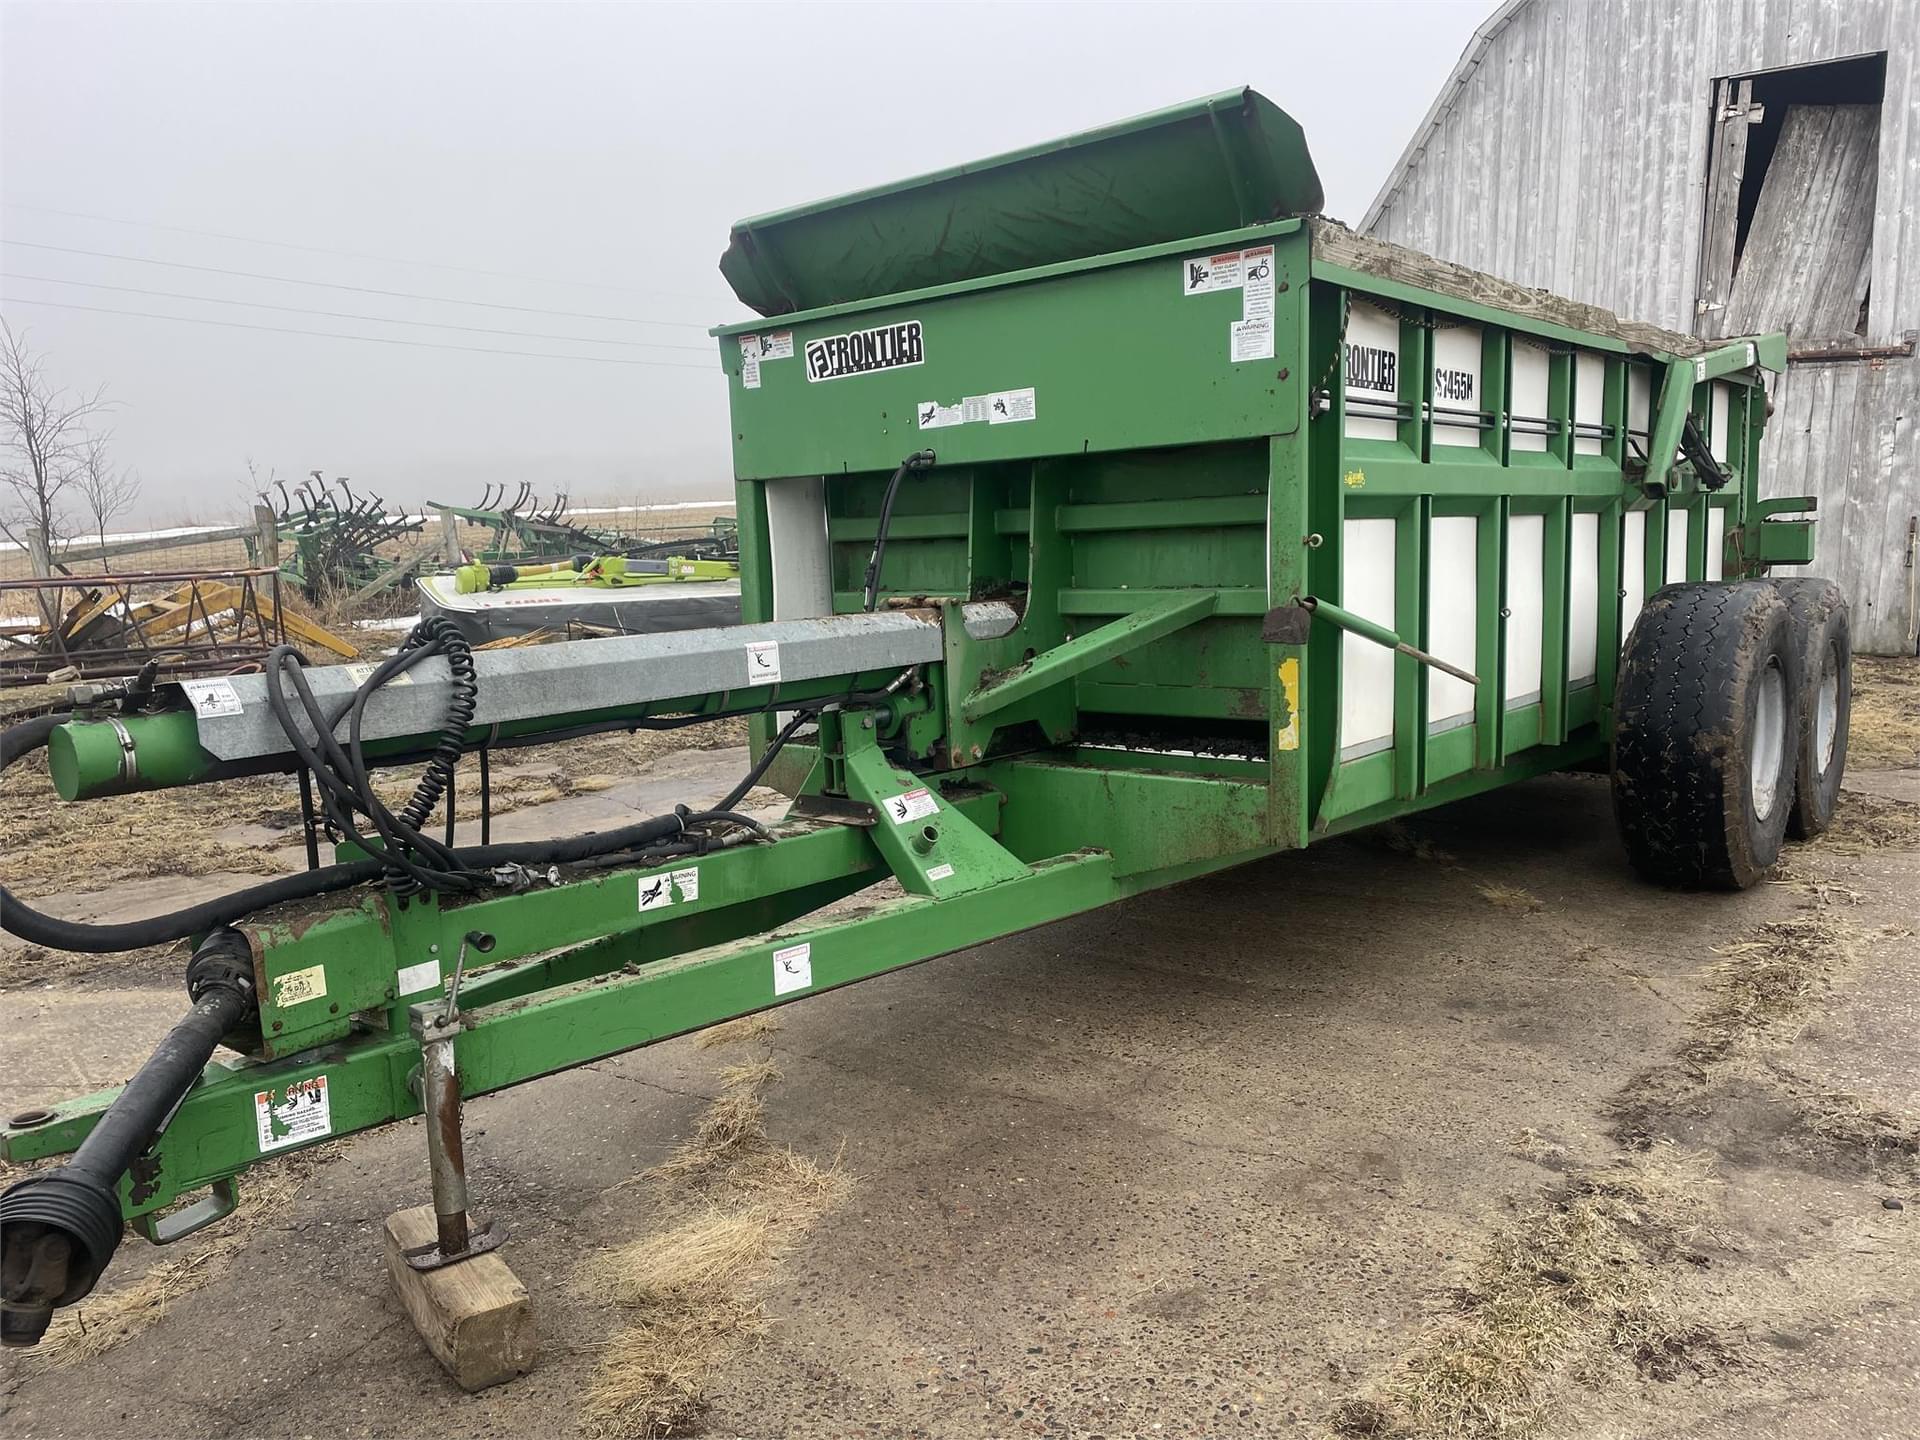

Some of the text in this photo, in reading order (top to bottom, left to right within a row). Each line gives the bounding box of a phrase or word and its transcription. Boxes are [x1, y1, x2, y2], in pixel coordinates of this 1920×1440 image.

[824, 323, 922, 371] FRONTIER
[833, 354, 918, 376] EQUIPMENT
[1345, 343, 1396, 391] RONTIER
